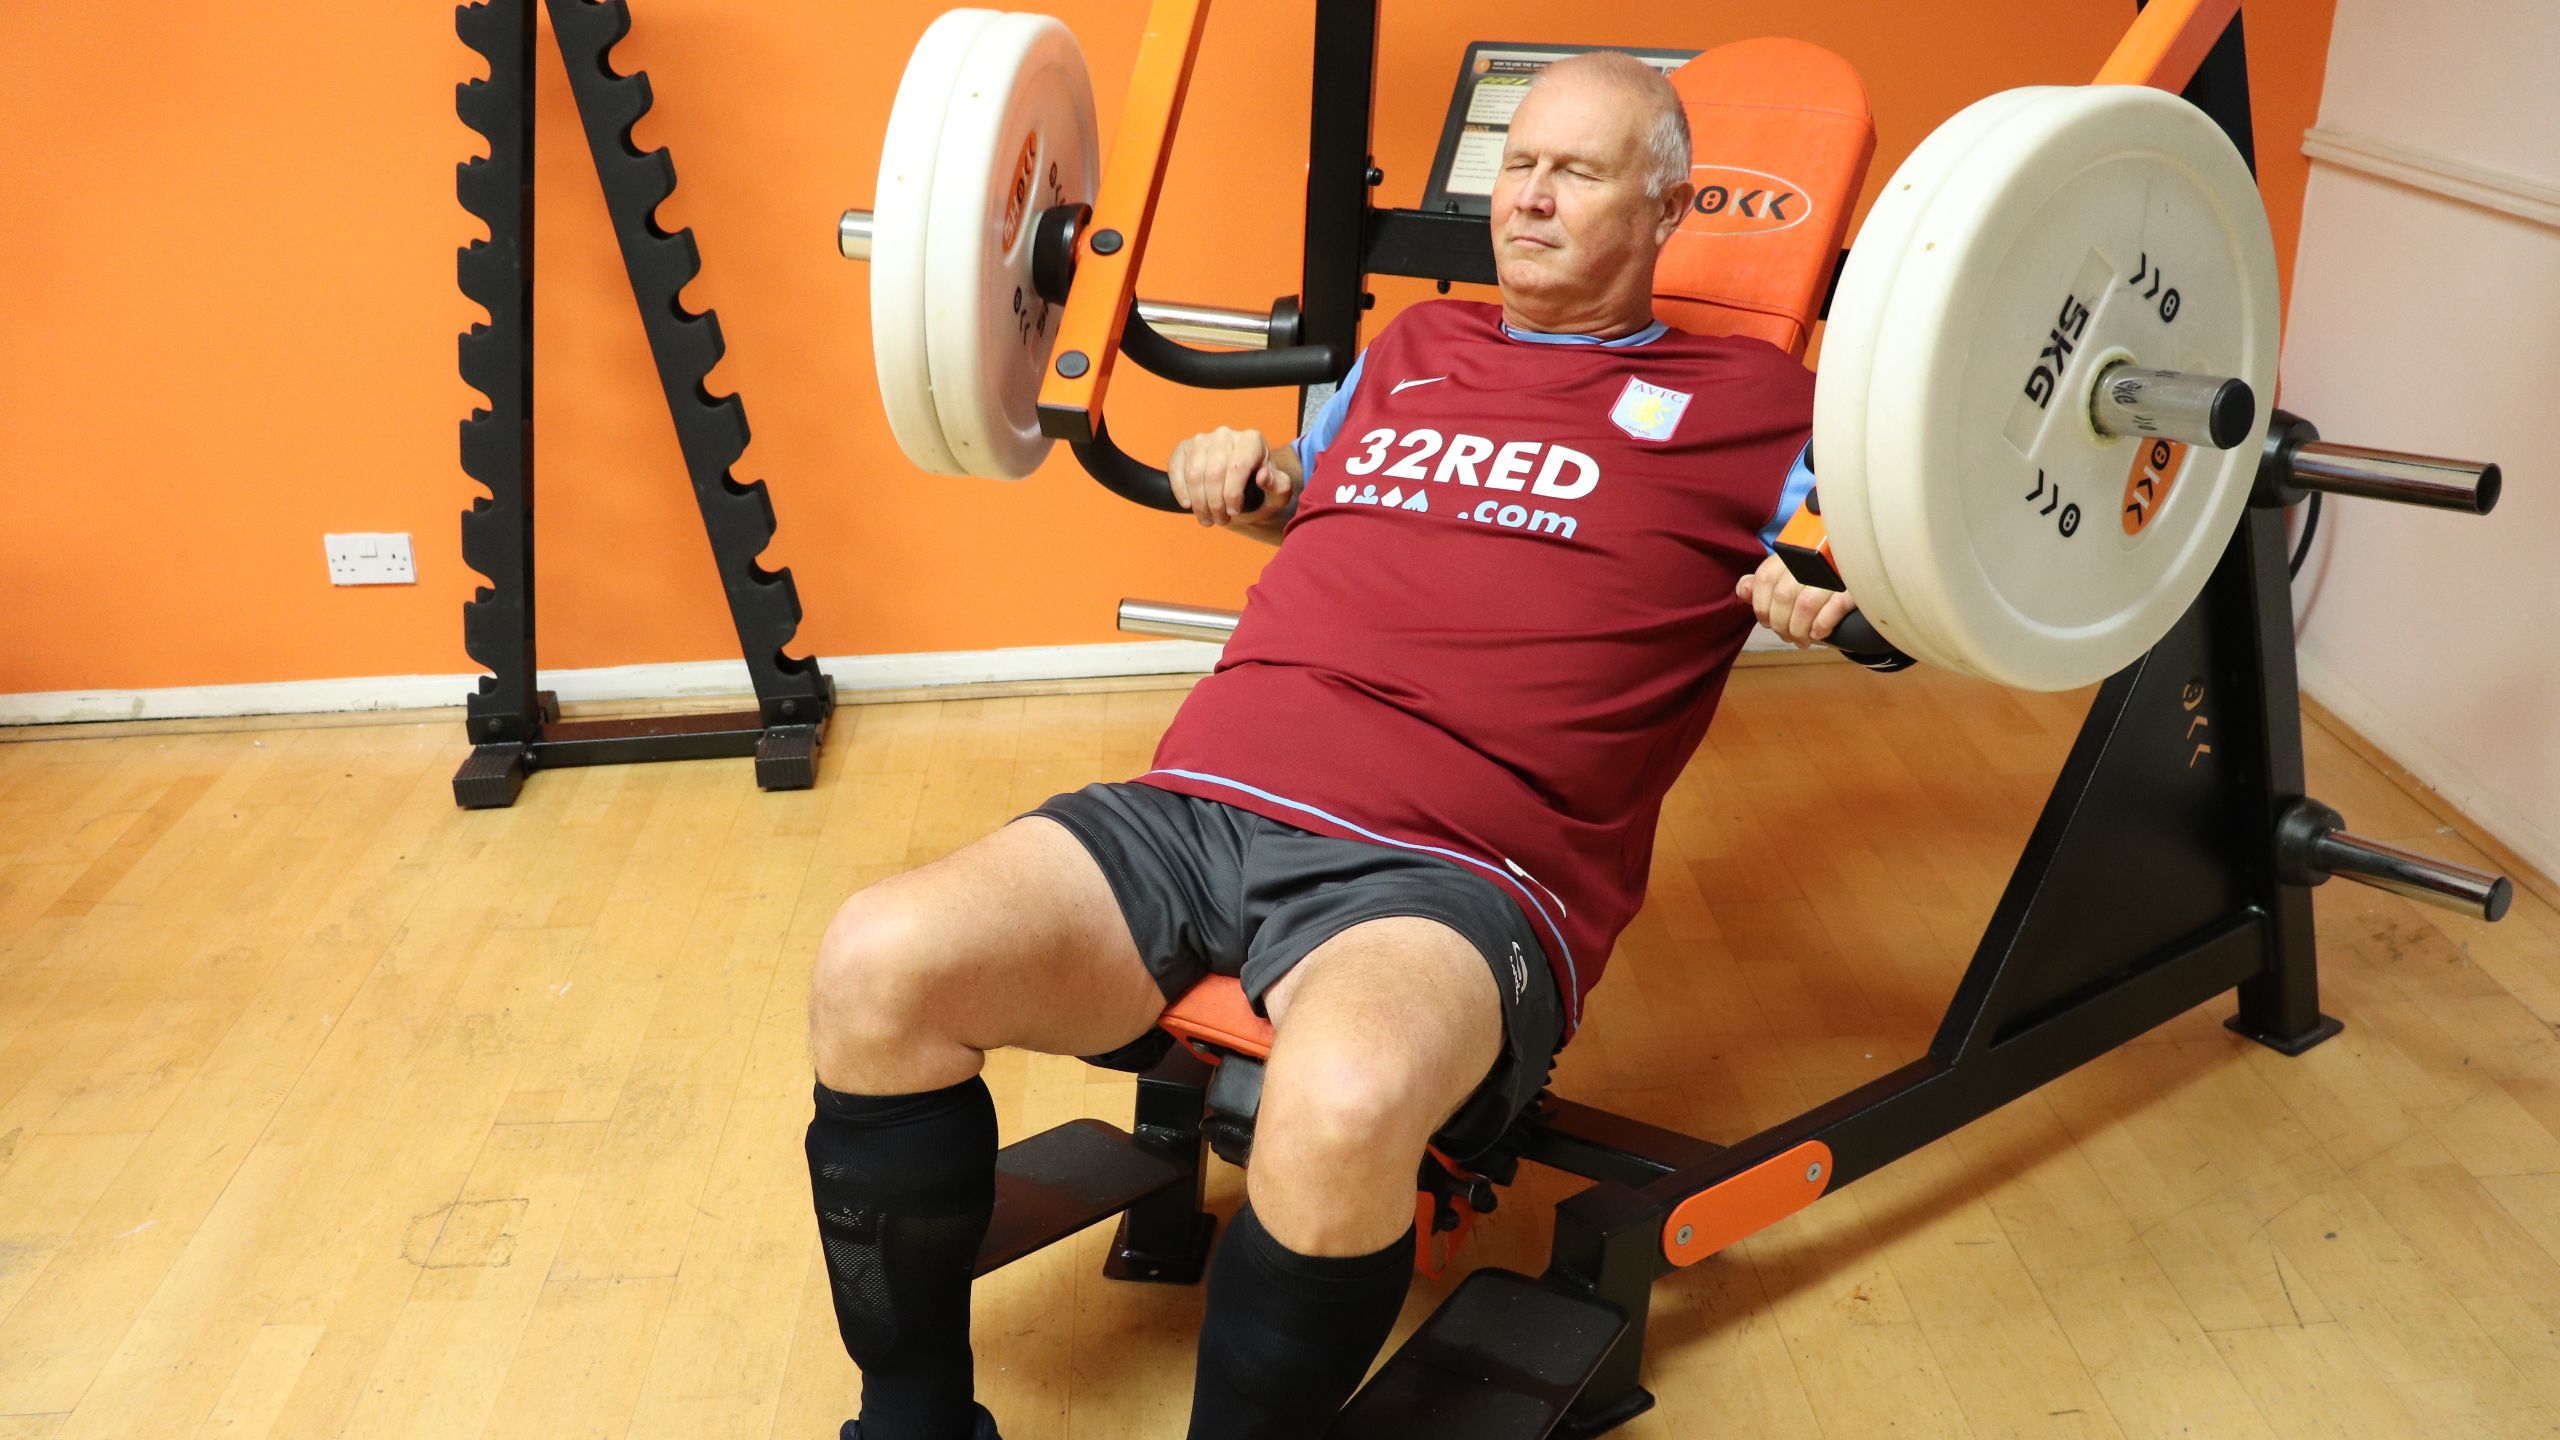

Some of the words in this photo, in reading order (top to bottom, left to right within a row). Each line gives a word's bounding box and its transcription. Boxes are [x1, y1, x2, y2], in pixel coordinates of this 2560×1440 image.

[1694, 185, 1795, 221] OKK
[2024, 294, 2090, 410] 5KG
[1634, 383, 1684, 404] AVFC
[1345, 428, 1600, 500] 32RED
[2126, 440, 2170, 527] OKK
[1457, 500, 1578, 539] .com
